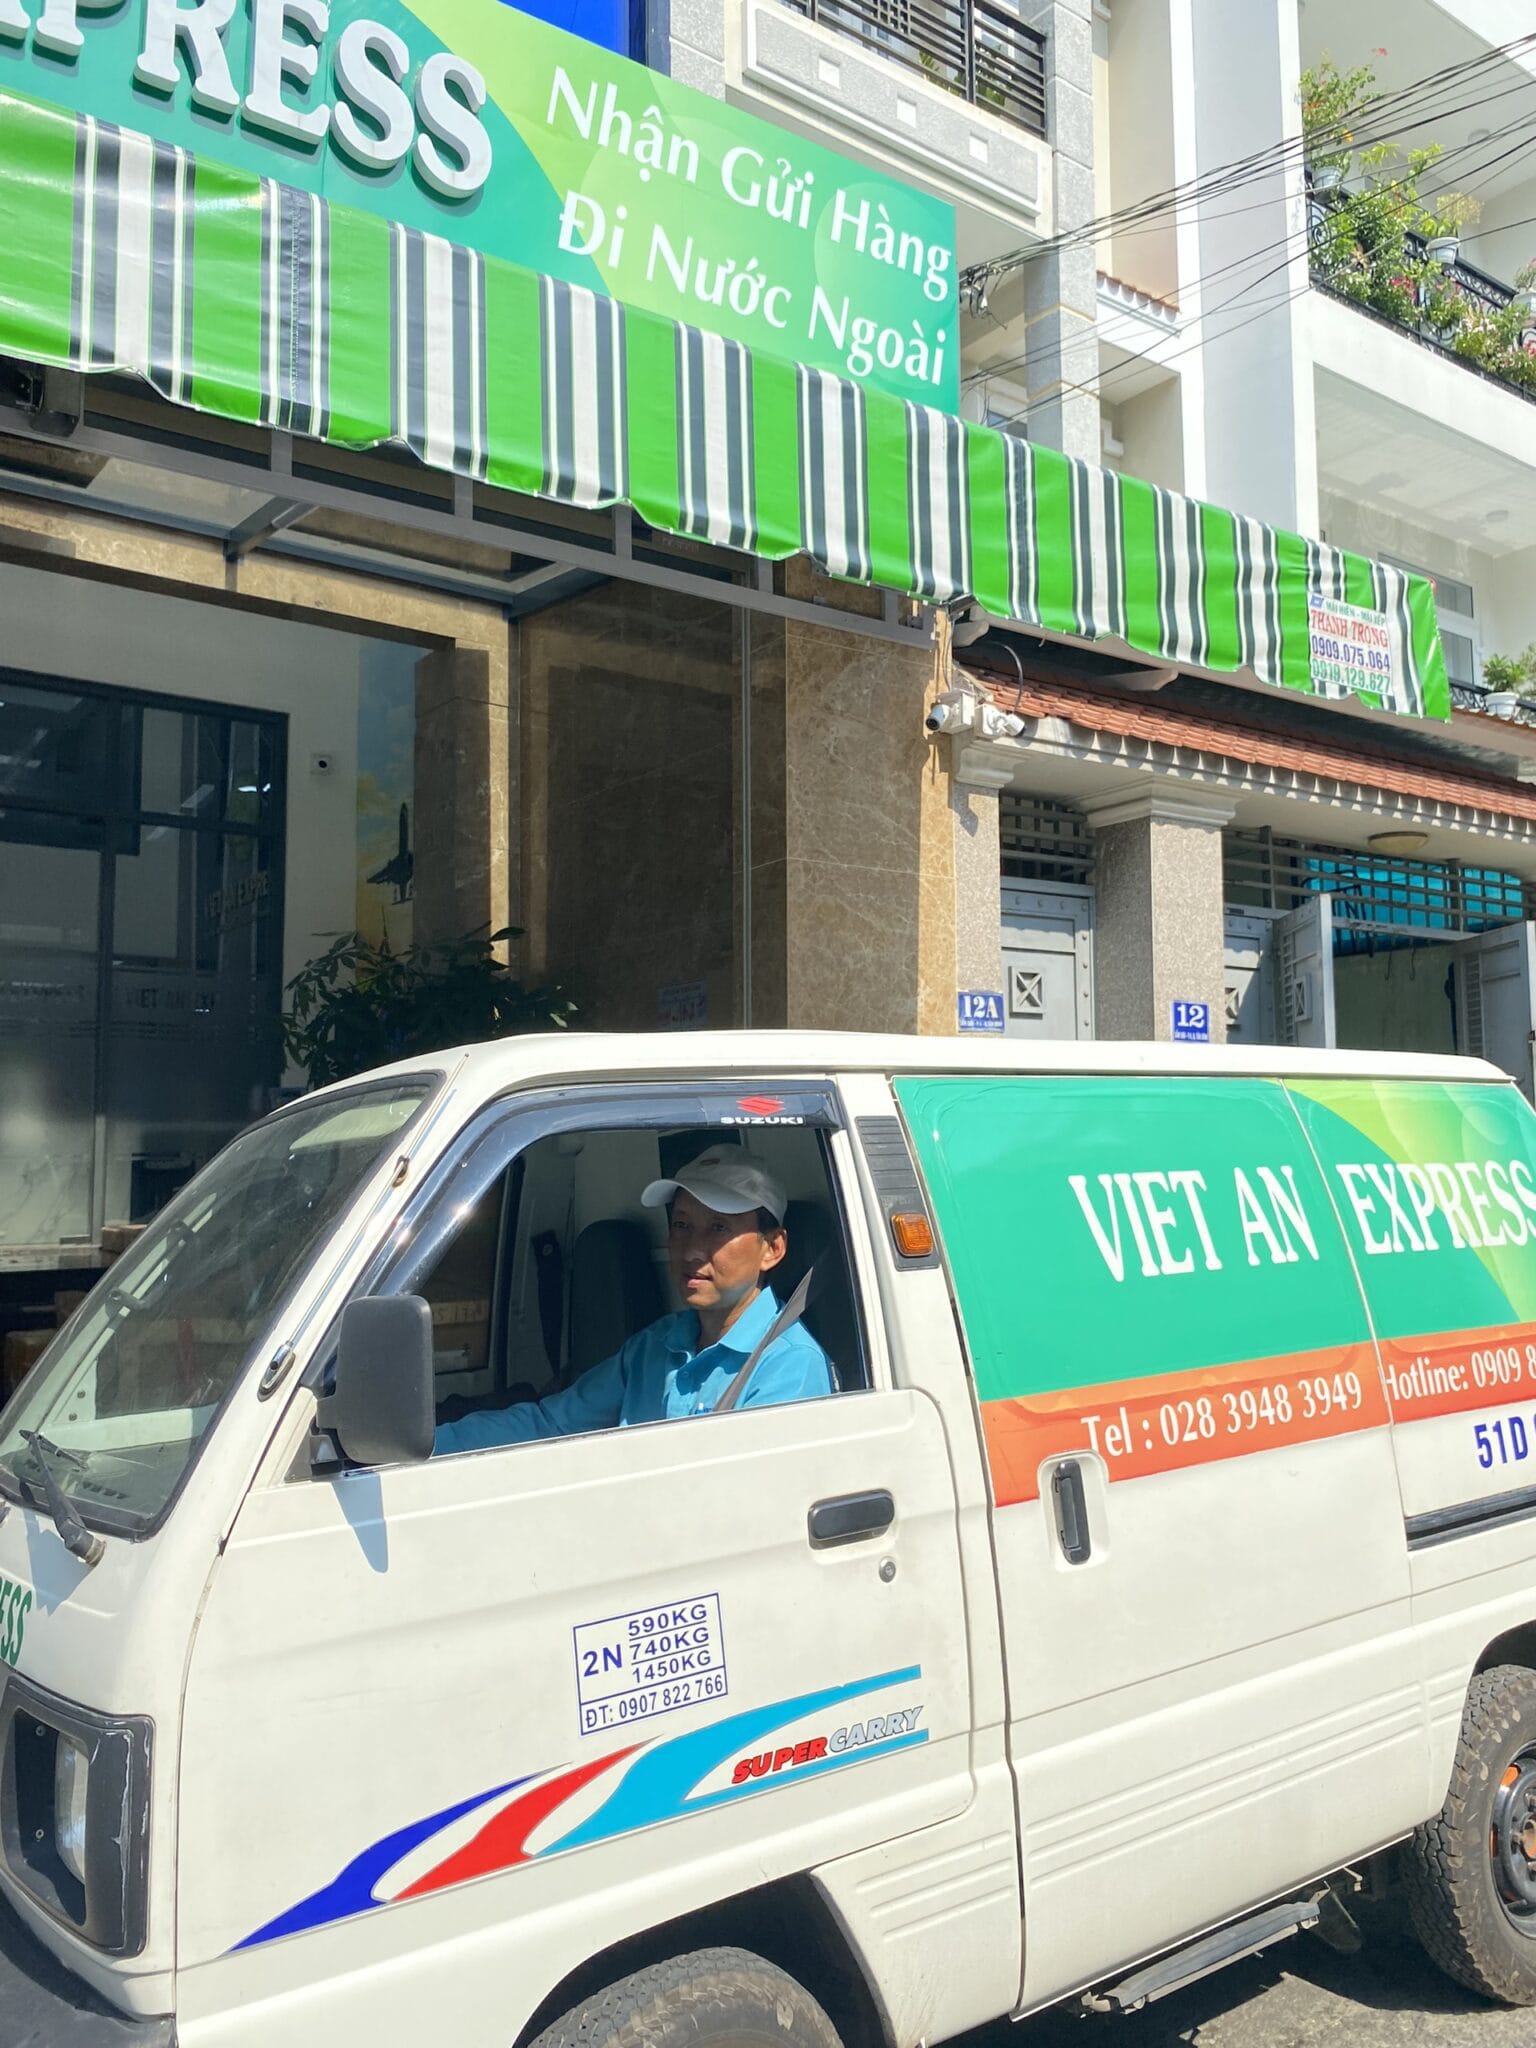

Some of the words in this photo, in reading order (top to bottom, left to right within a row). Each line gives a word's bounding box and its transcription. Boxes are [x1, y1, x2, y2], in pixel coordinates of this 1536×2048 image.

[0, 0, 492, 196] RESS
[546, 66, 699, 183] Nhận
[721, 146, 814, 230] Gửi
[830, 189, 952, 301] Hàng
[557, 190, 628, 270] Đi
[645, 224, 793, 328] Nước
[807, 285, 946, 386] Ngoài
[1311, 610, 1348, 638] THANH
[1312, 635, 1390, 672] 0909.075.064
[963, 995, 999, 1018] 12A
[1177, 1004, 1205, 1028] 12
[720, 1116, 804, 1125] SUZUKI
[1068, 1170, 1223, 1282] VIET
[1233, 1165, 1319, 1266] AN
[1336, 1160, 1536, 1254] EXPRESS
[1471, 1347, 1522, 1388] 0909
[1080, 1406, 1133, 1456] Tel
[1160, 1398, 1217, 1446] 028
[1221, 1384, 1293, 1434] 3948
[1297, 1372, 1362, 1419] 3949
[1473, 1416, 1529, 1469] 51D
[628, 1603, 708, 1637] 590KG
[582, 1643, 623, 1677] 2N
[630, 1627, 710, 1661] 740KG
[632, 1649, 712, 1684] 1450KG
[585, 1705, 614, 1728] ĐT:
[618, 1692, 657, 1719] 0907
[662, 1685, 692, 1707] 822
[695, 1674, 724, 1699] 766
